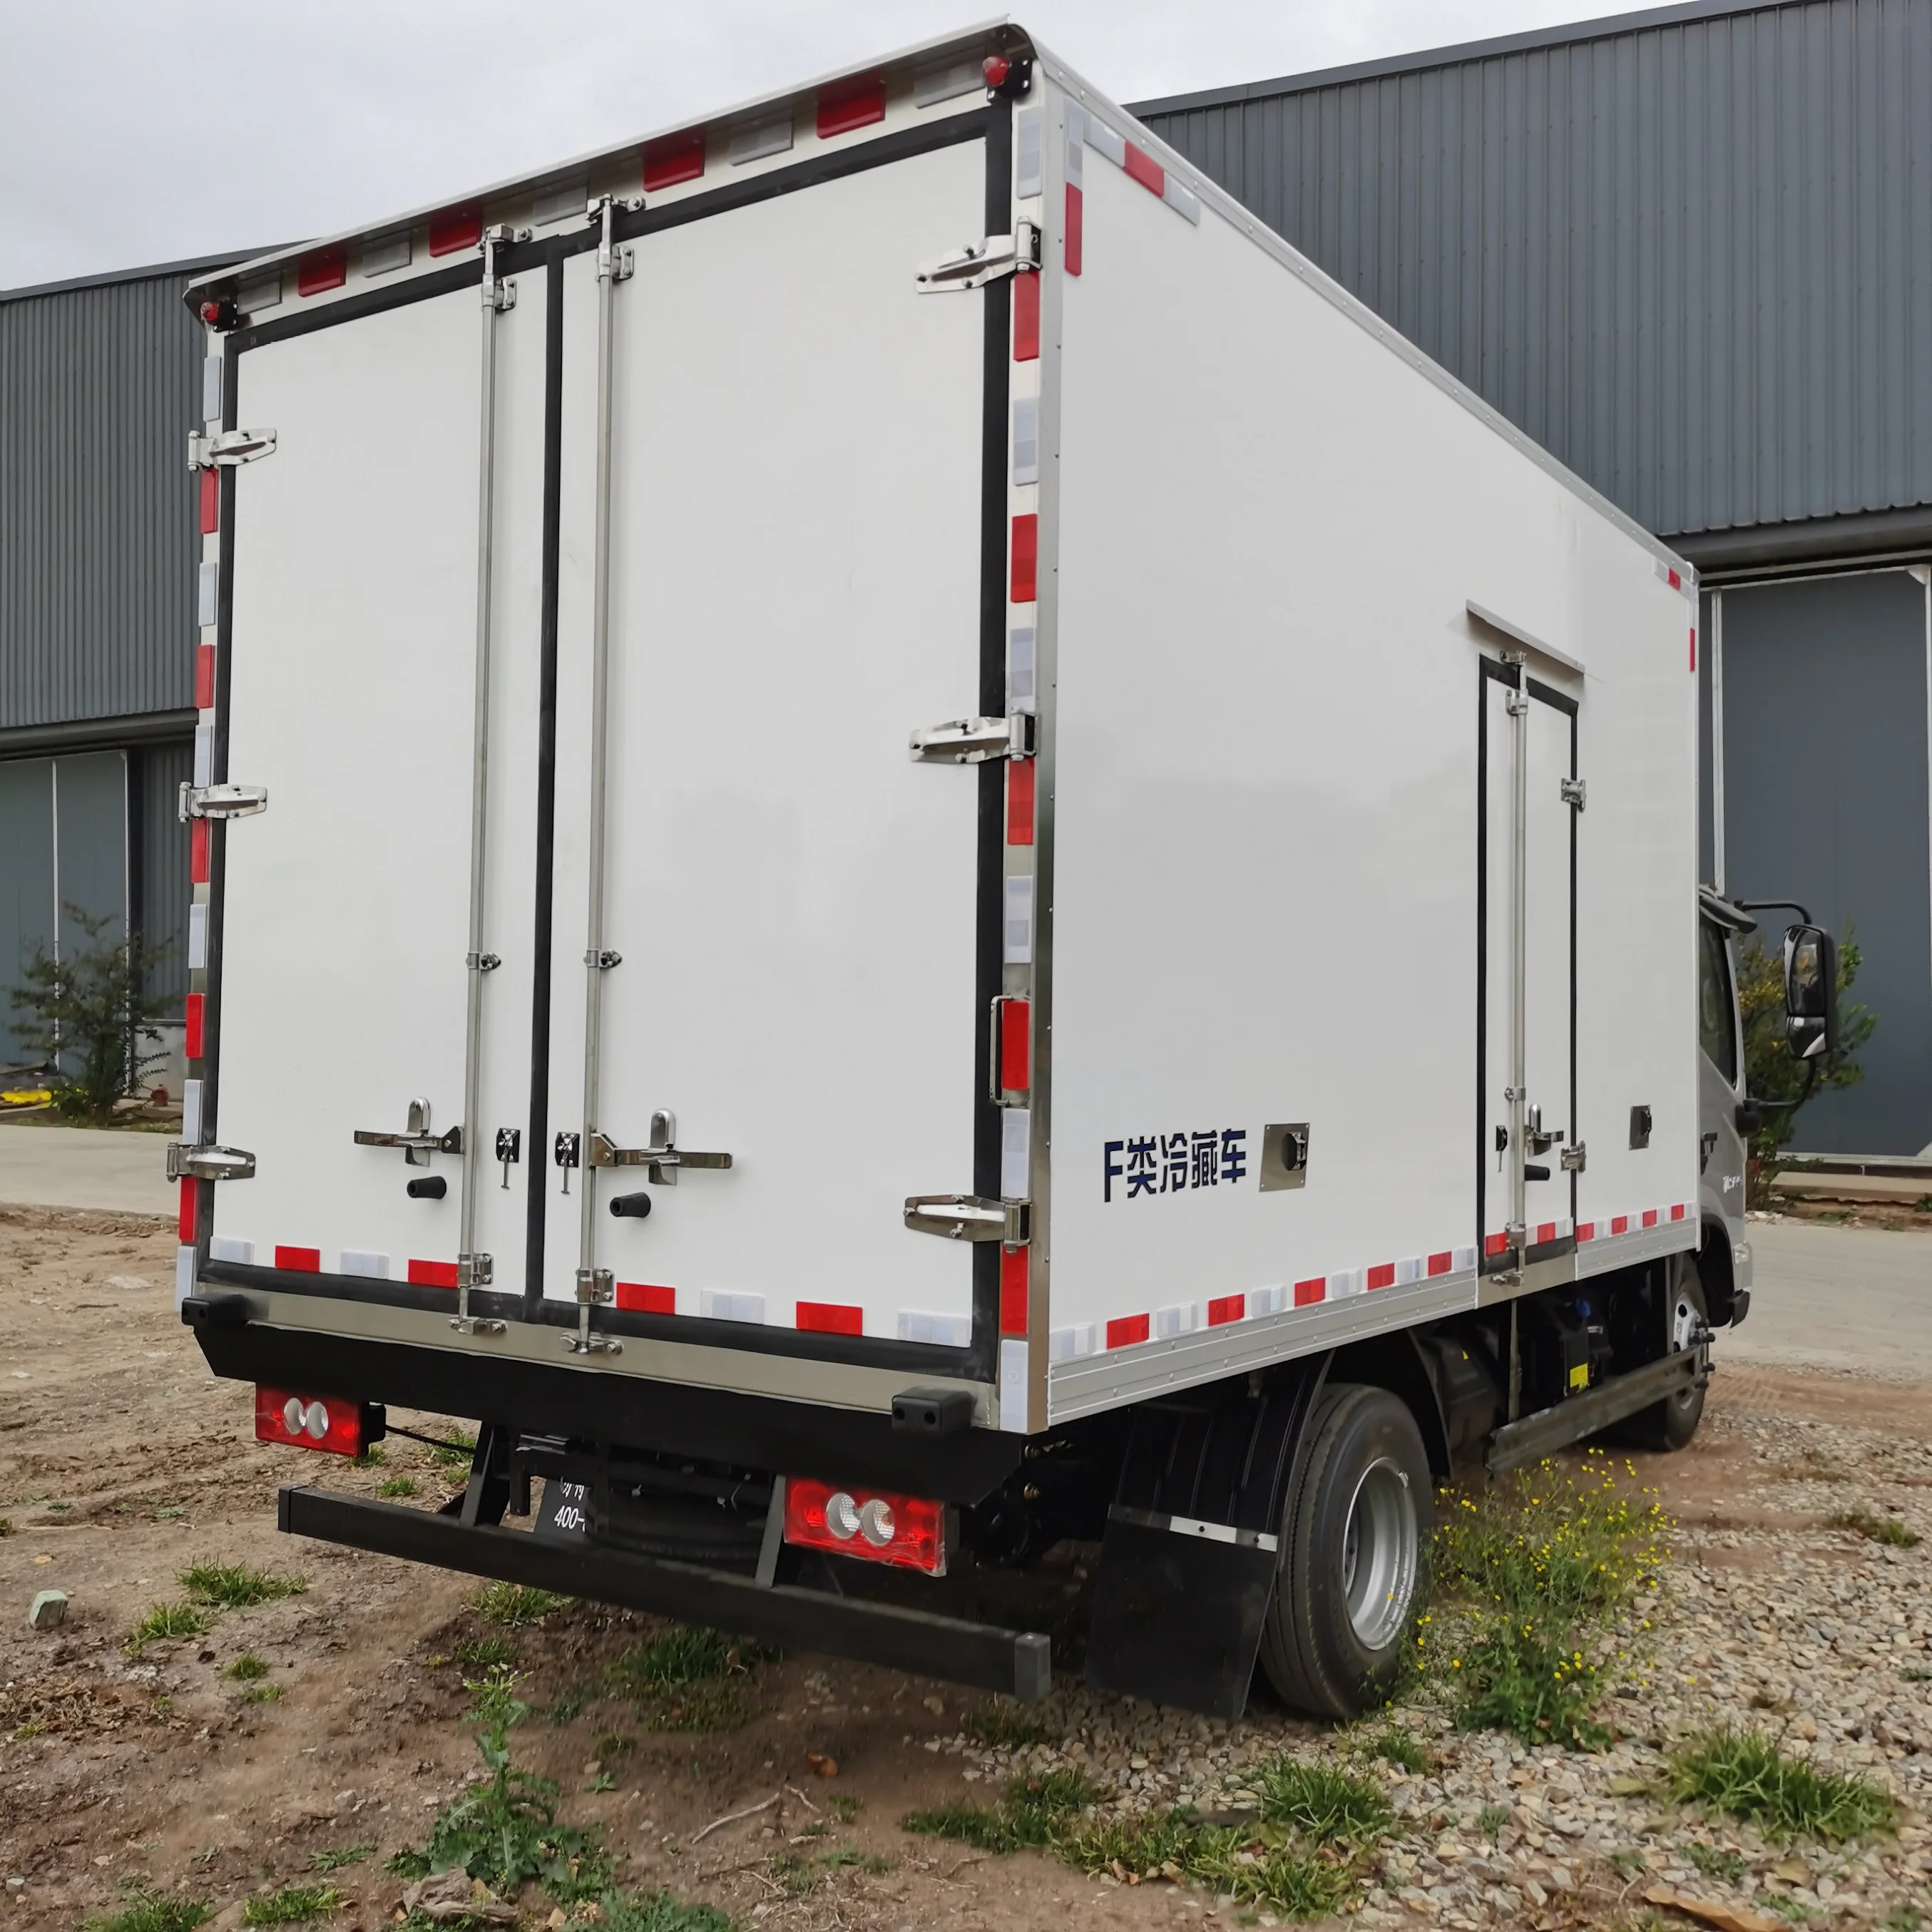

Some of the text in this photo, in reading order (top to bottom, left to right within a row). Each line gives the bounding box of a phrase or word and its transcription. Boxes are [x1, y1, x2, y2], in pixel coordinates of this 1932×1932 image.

[1104, 1128, 1247, 1202] F类冷藏车
[553, 1504, 586, 1533] 400-
